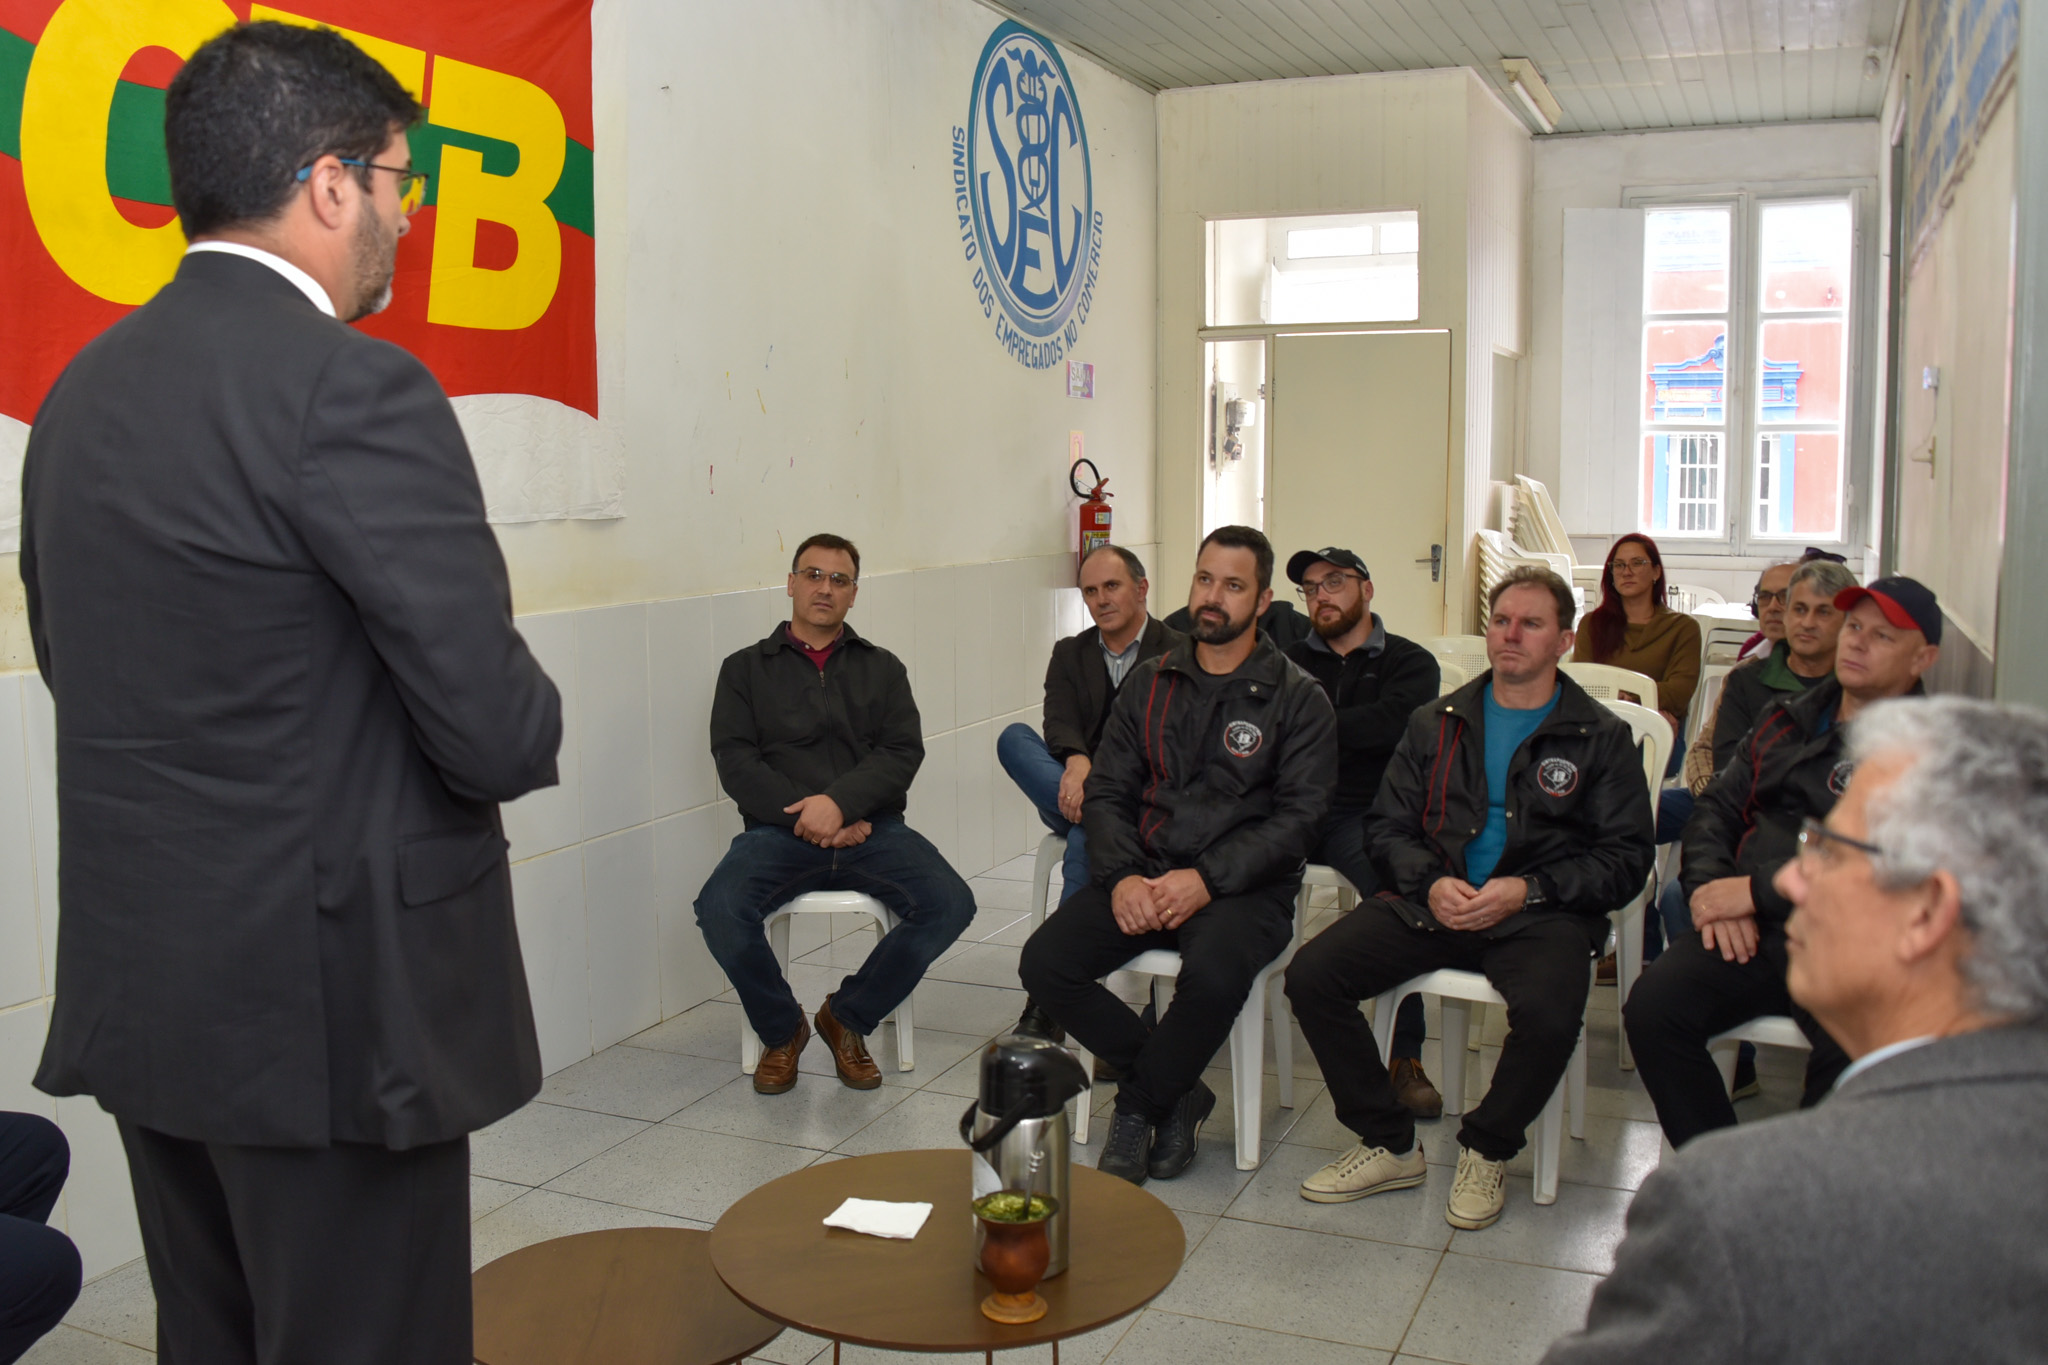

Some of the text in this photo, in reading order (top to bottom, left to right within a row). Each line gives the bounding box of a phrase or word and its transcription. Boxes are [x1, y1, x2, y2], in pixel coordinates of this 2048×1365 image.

[20, 0, 567, 330] CB
[952, 125, 1103, 370] SINDICATO DOS EMPREGADOS NO COMERCIO
